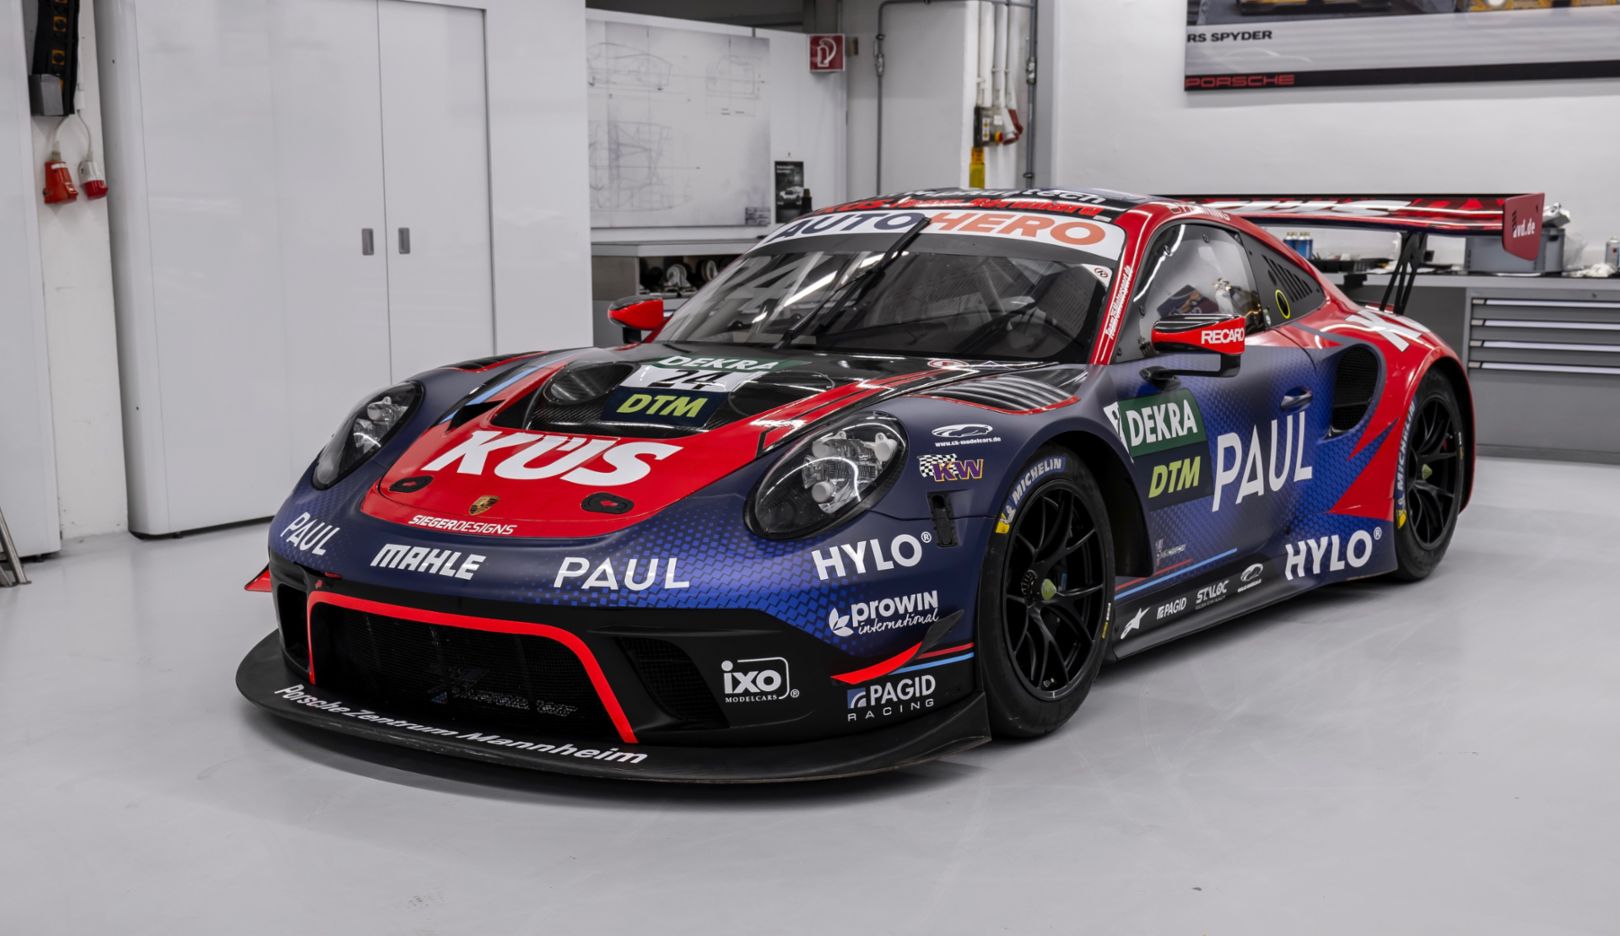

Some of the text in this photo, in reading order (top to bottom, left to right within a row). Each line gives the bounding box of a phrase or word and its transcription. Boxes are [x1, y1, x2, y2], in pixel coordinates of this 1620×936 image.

[1187, 30, 1272, 42] RS SPYDER
[1185, 74, 1295, 88] PORSCHE
[1512, 218, 1536, 238] avd.de
[1201, 328, 1245, 345] RECARO
[658, 355, 779, 370] DEKRA
[617, 393, 708, 418] DTM
[1126, 399, 1198, 447] DEKRA
[421, 430, 684, 487] KÜS
[931, 458, 985, 482] KW
[1211, 411, 1313, 513] PAUL
[1011, 457, 1063, 504] MICHELIN
[1148, 456, 1201, 499] DTM
[279, 511, 341, 556] PAUL
[408, 514, 518, 536] SIEGERDESIGNS
[370, 543, 487, 581] MAHLE
[553, 556, 690, 591] PAUL
[1163, 597, 1187, 617] PAGID
[858, 608, 940, 635] international
[724, 694, 777, 703] MODELCARS
[869, 674, 936, 707] PAGID
[847, 698, 935, 722] RACING
[274, 683, 648, 764] Porsche Zentrum Mannheim
